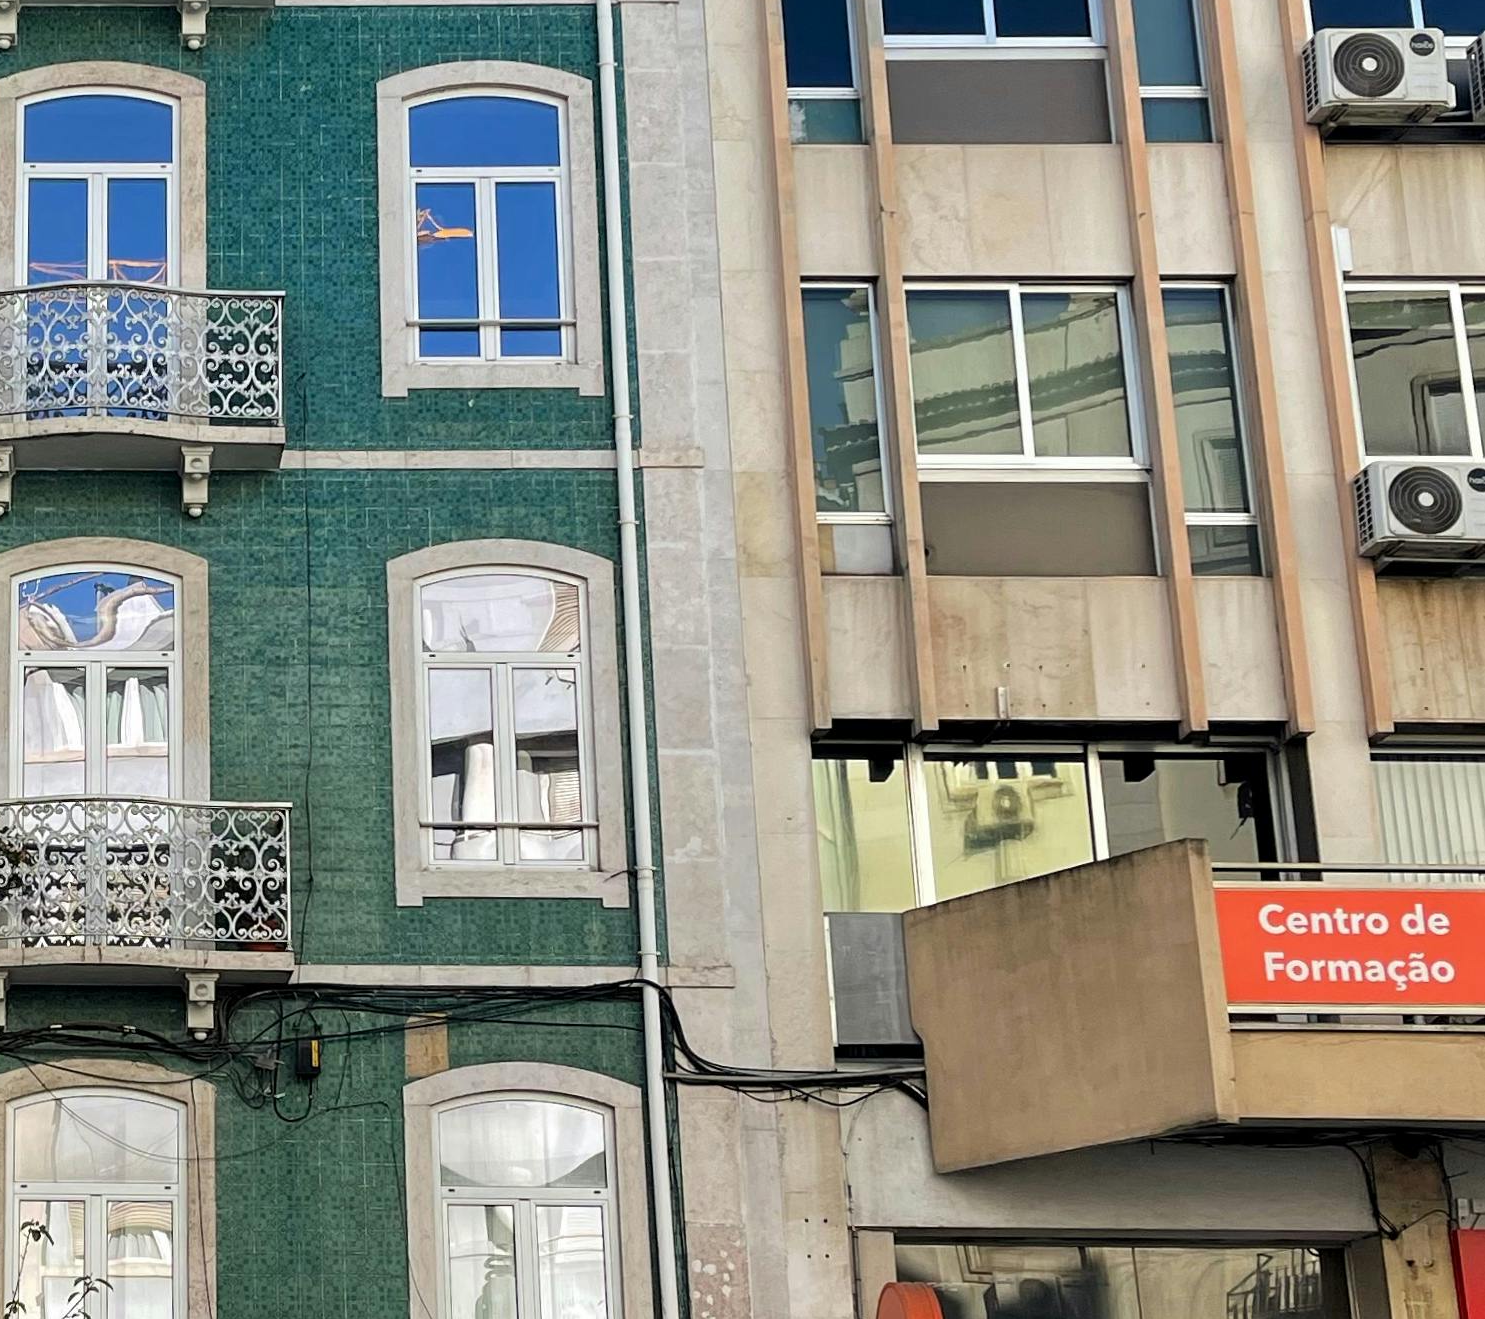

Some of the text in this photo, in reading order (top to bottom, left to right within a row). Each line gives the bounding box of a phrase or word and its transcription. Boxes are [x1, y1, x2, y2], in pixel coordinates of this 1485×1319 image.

[1258, 903, 1451, 935] Centro de
[1263, 951, 1456, 991] Formação
